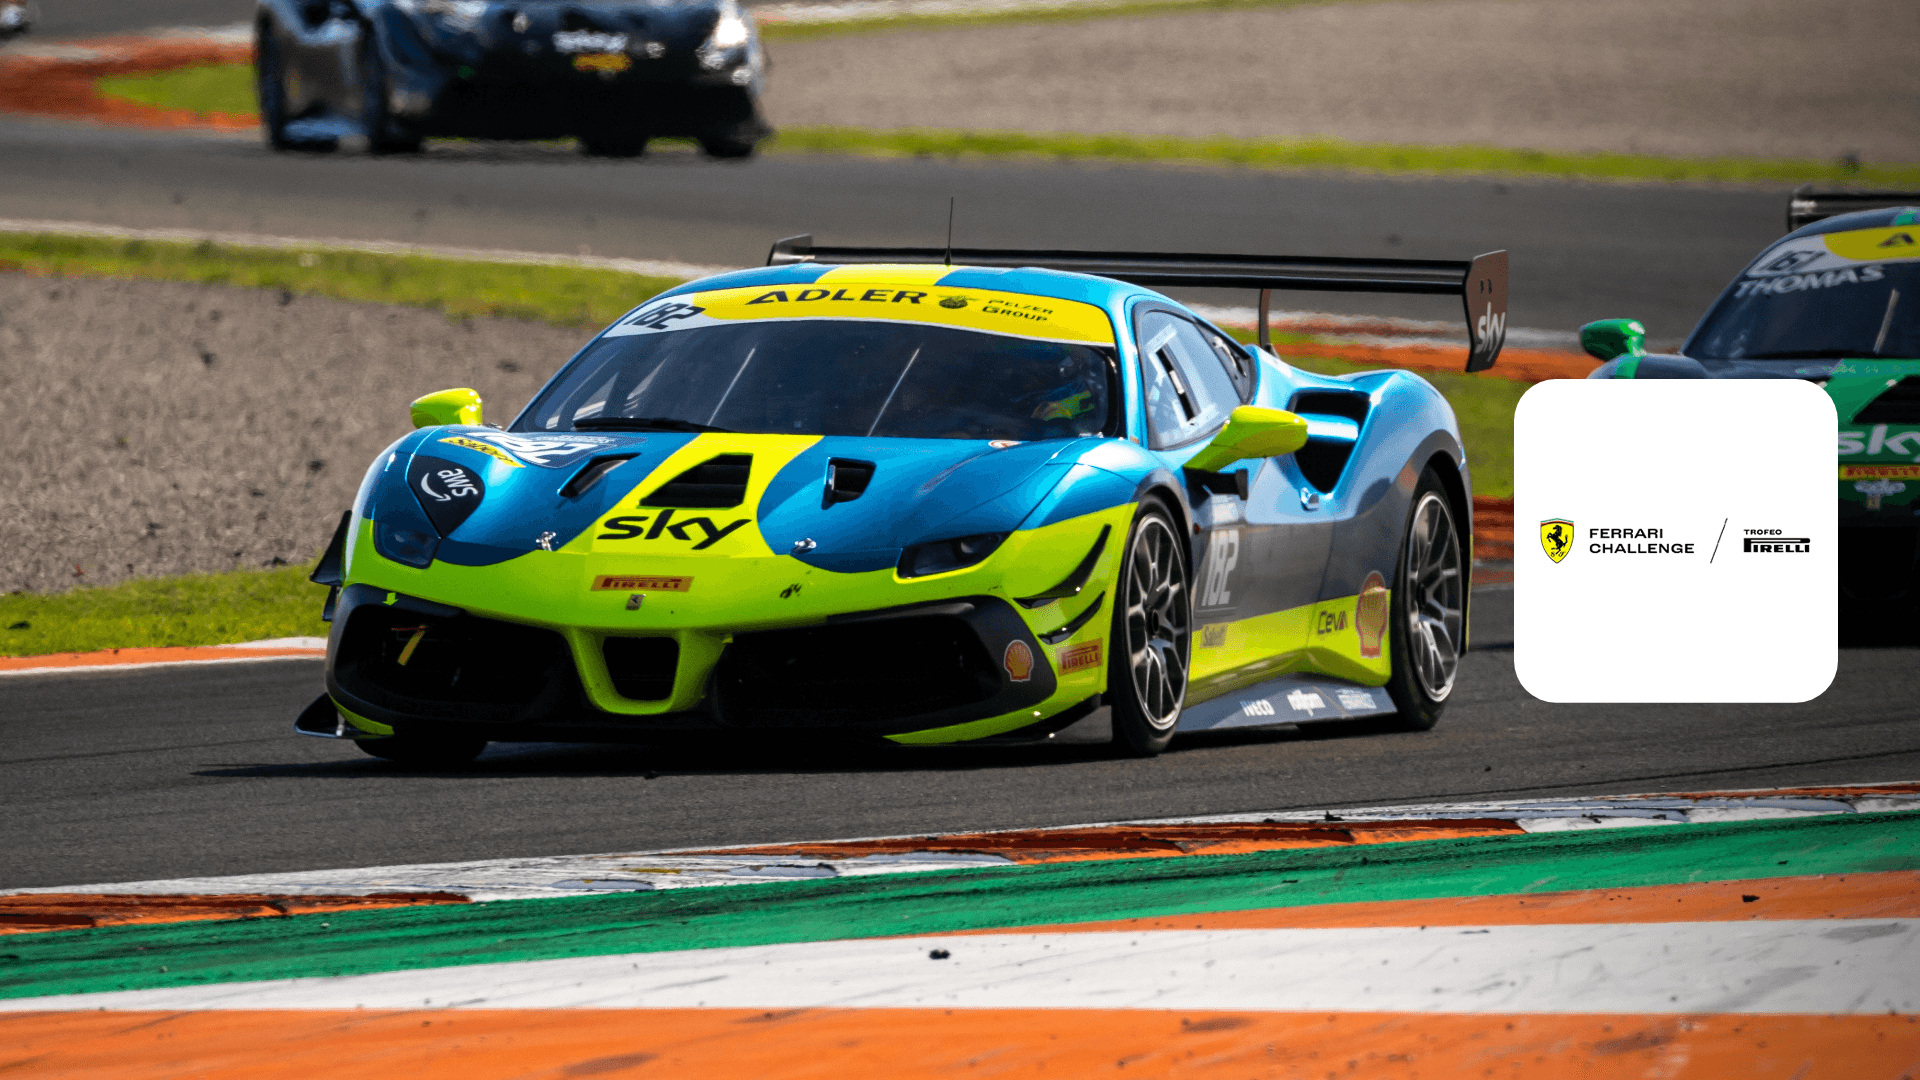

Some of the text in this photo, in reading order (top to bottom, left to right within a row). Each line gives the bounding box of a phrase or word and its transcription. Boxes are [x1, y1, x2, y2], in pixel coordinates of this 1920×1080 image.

[1733, 265, 1885, 298] THOMAS
[744, 289, 928, 305] ADLER
[622, 302, 706, 330] 182
[982, 306, 1047, 321] GROUP
[1474, 301, 1506, 362] sky
[437, 468, 479, 497] aws
[596, 508, 753, 551] sky
[1201, 528, 1240, 607] 182
[601, 577, 683, 588] PIRELLI
[1061, 644, 1098, 669] PIRELLI
